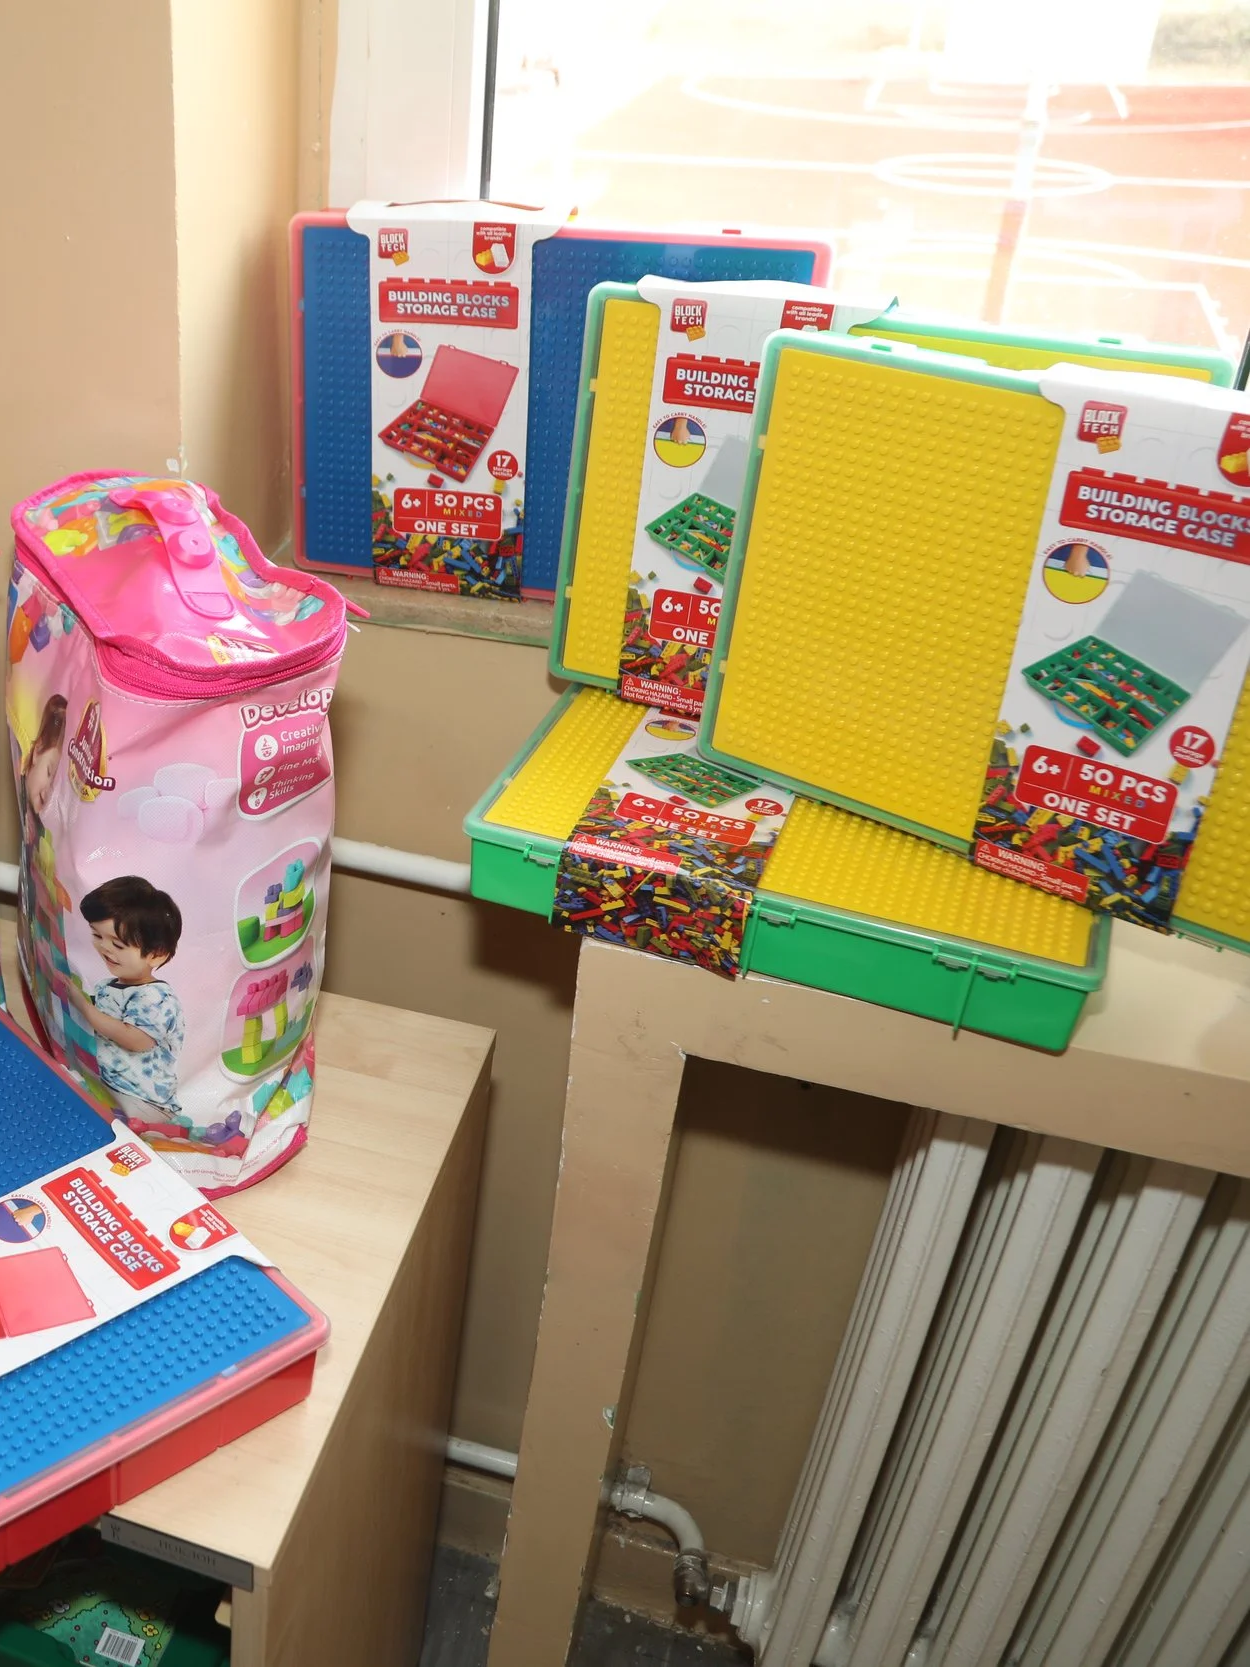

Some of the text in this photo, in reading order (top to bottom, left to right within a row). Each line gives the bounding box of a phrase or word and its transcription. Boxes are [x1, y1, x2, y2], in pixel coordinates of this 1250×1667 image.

[380, 233, 404, 244] BLOCK
[381, 243, 406, 252] TECH
[388, 290, 510, 307] BUILDING BLOCKS
[397, 303, 497, 319] STORAGE CASE
[674, 304, 702, 317] BLOCK
[674, 315, 703, 325] TECH
[676, 368, 749, 389] BUILDING
[683, 383, 755, 403] STORAGE
[1083, 408, 1122, 425] BLOCK
[1082, 422, 1119, 435] TECH
[495, 454, 512, 468] 17
[401, 493, 496, 512] 6+ 50 PCS
[1078, 485, 1172, 516] BUILDING
[443, 508, 483, 519] MIXED
[414, 520, 479, 537] ONE SET
[1086, 504, 1237, 548] STORAGE CASE
[392, 570, 430, 581] WARNING:
[661, 596, 684, 613] 6+
[672, 627, 709, 645] ONE
[624, 685, 649, 696] CHOKING
[650, 691, 673, 701] HAZARD
[676, 695, 694, 705] Small
[640, 680, 682, 696] WARNING:
[242, 688, 334, 728] Develop
[636, 692, 644, 700] for
[645, 695, 669, 706] children
[670, 701, 688, 710] under
[280, 720, 323, 742] Creativ
[282, 735, 322, 755] Imagina
[1183, 731, 1209, 750] 17
[69, 739, 113, 788] Construction
[278, 761, 300, 773] Fine
[272, 772, 315, 789] Thinking
[1032, 755, 1168, 803] 6+ 50 PCS
[269, 784, 295, 800] Skills
[1088, 785, 1146, 809] MIXED
[756, 800, 778, 809] 17
[1043, 793, 1136, 831] ONE SET
[631, 798, 747, 830] 6+ 50 PCS
[641, 815, 722, 840] ONE SET
[680, 817, 729, 831] MIXED
[595, 838, 643, 854] WARNING:
[571, 845, 585, 853] Not
[586, 847, 596, 855] for
[596, 850, 625, 862] children
[626, 858, 649, 867] under
[636, 853, 656, 863] Small
[998, 849, 1048, 873] WARNING:
[1040, 873, 1062, 885] Small
[114, 1149, 138, 1170] TECH
[119, 1145, 144, 1166] BLOCK
[62, 1191, 143, 1273] STORAGE CASE
[69, 1176, 165, 1274] BUILDING BLOCKS
